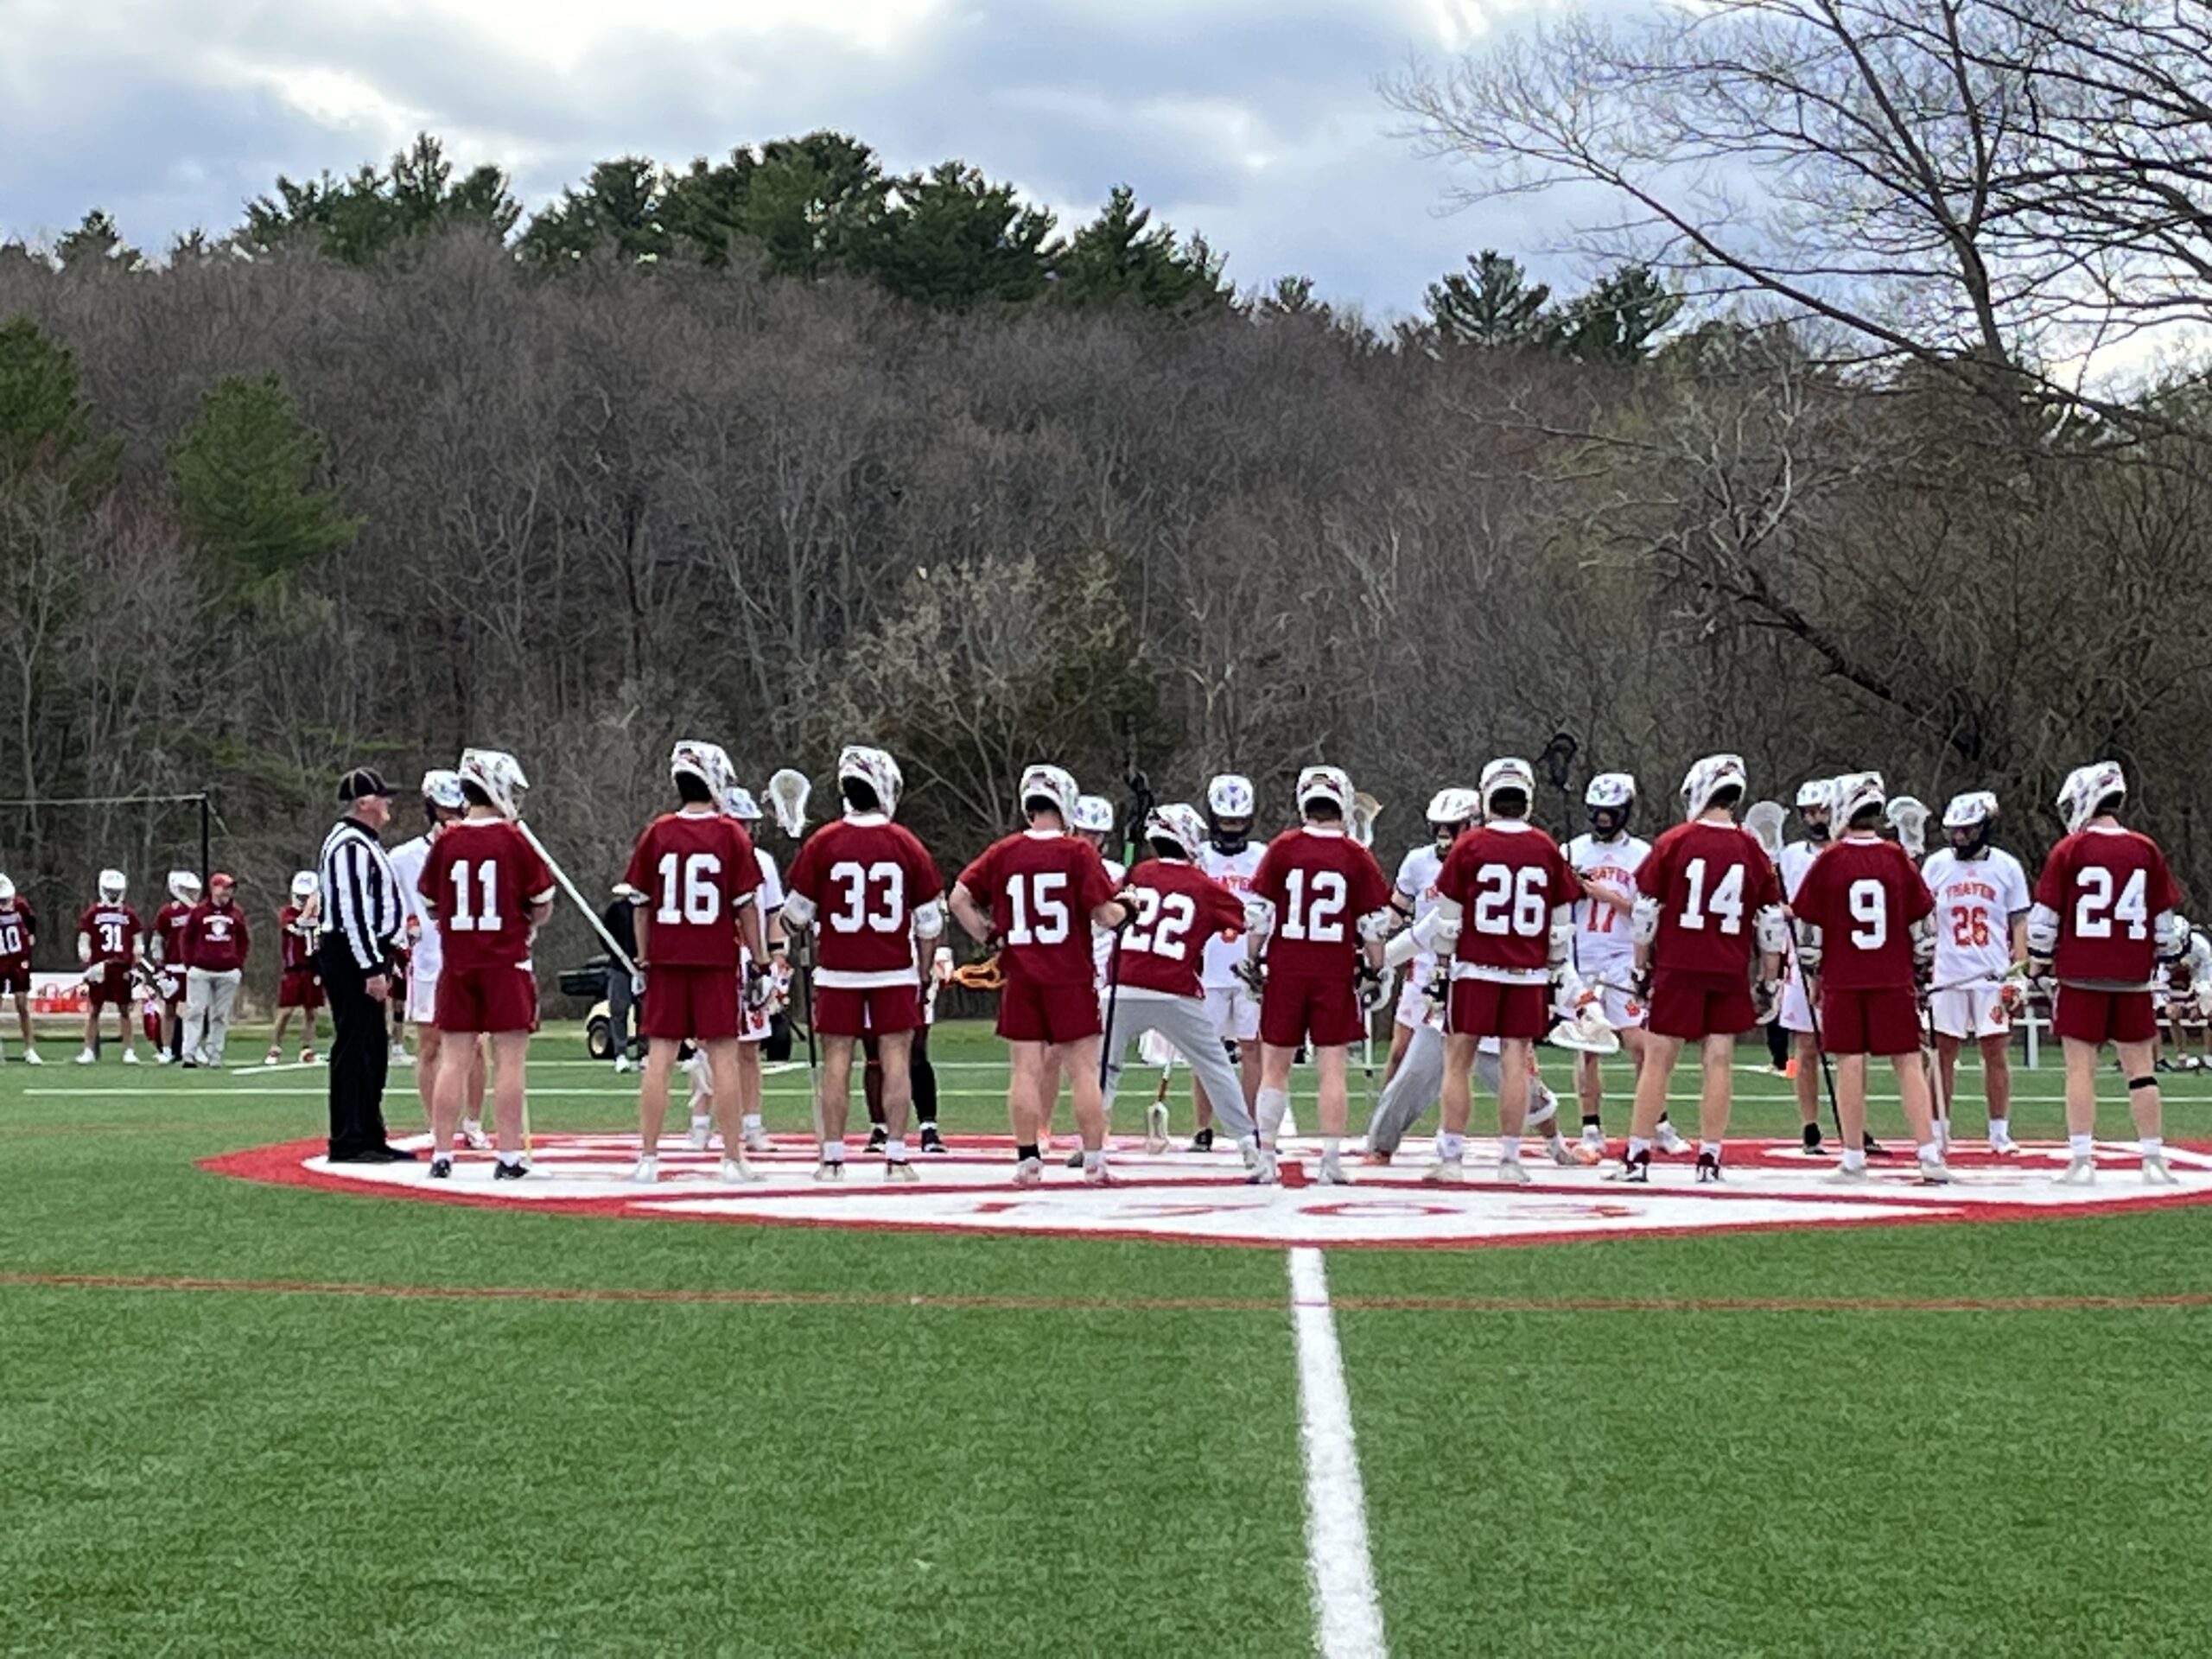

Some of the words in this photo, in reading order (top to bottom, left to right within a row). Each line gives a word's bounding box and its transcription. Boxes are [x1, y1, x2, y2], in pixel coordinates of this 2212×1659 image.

[450, 861, 501, 930] 11
[658, 854, 720, 924] 16
[830, 862, 903, 932] 33
[1007, 873, 1068, 944] 15
[1121, 887, 1195, 960] 22
[1282, 869, 1346, 941] 12
[1475, 864, 1547, 936] 26
[1680, 859, 1744, 934] 14
[1850, 880, 1885, 949] 9
[2076, 867, 2146, 939] 24
[99, 924, 124, 952] 31
[1951, 906, 1988, 946] 26
